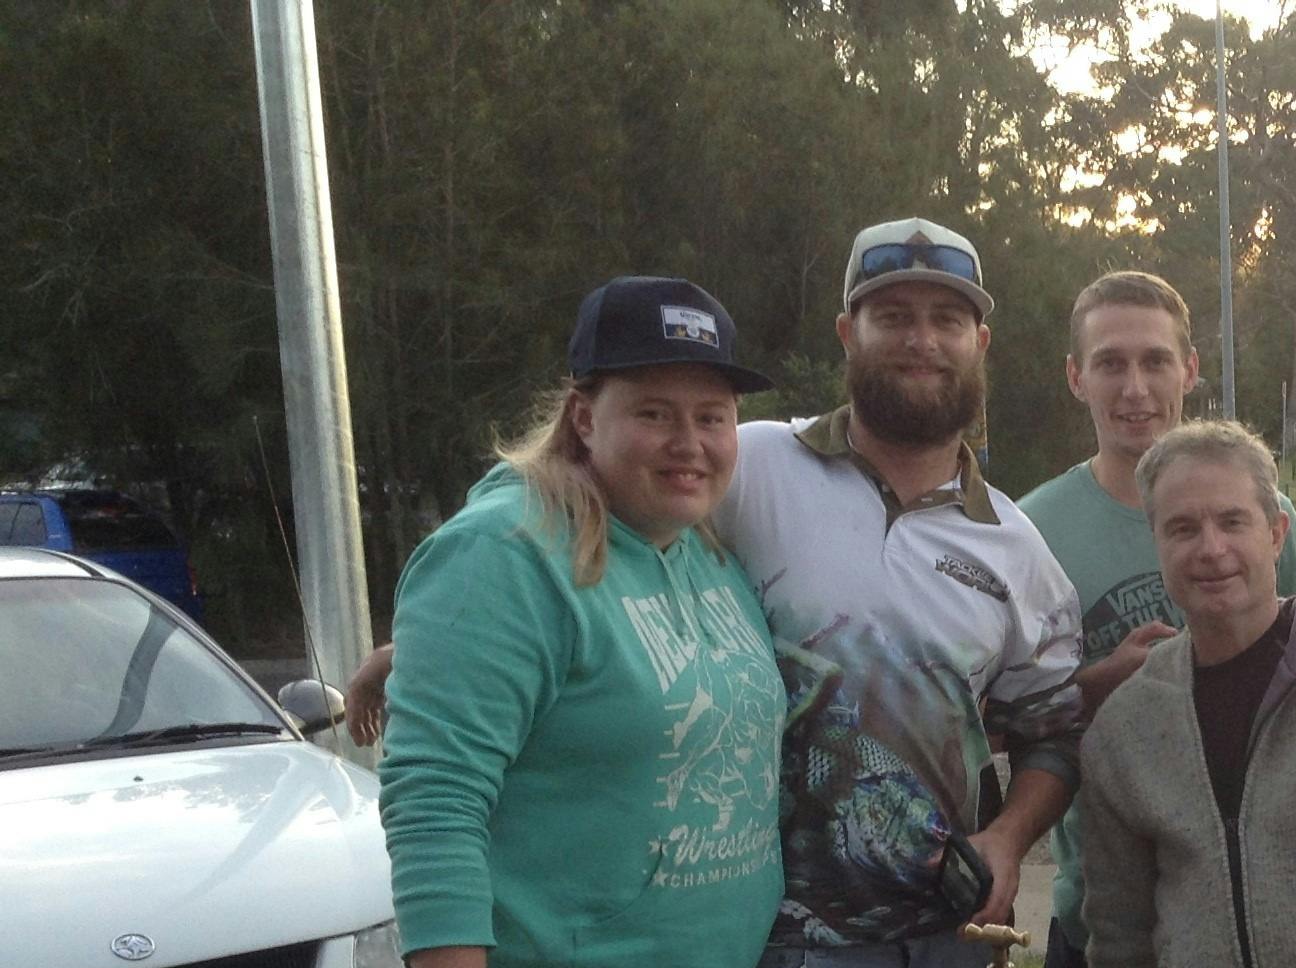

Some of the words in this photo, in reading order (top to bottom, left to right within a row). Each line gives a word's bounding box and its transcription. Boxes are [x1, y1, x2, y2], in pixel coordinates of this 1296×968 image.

[1105, 574, 1164, 617] VANS
[669, 817, 778, 866] Wrestling
[670, 849, 778, 888] CHAMPIONSPS
